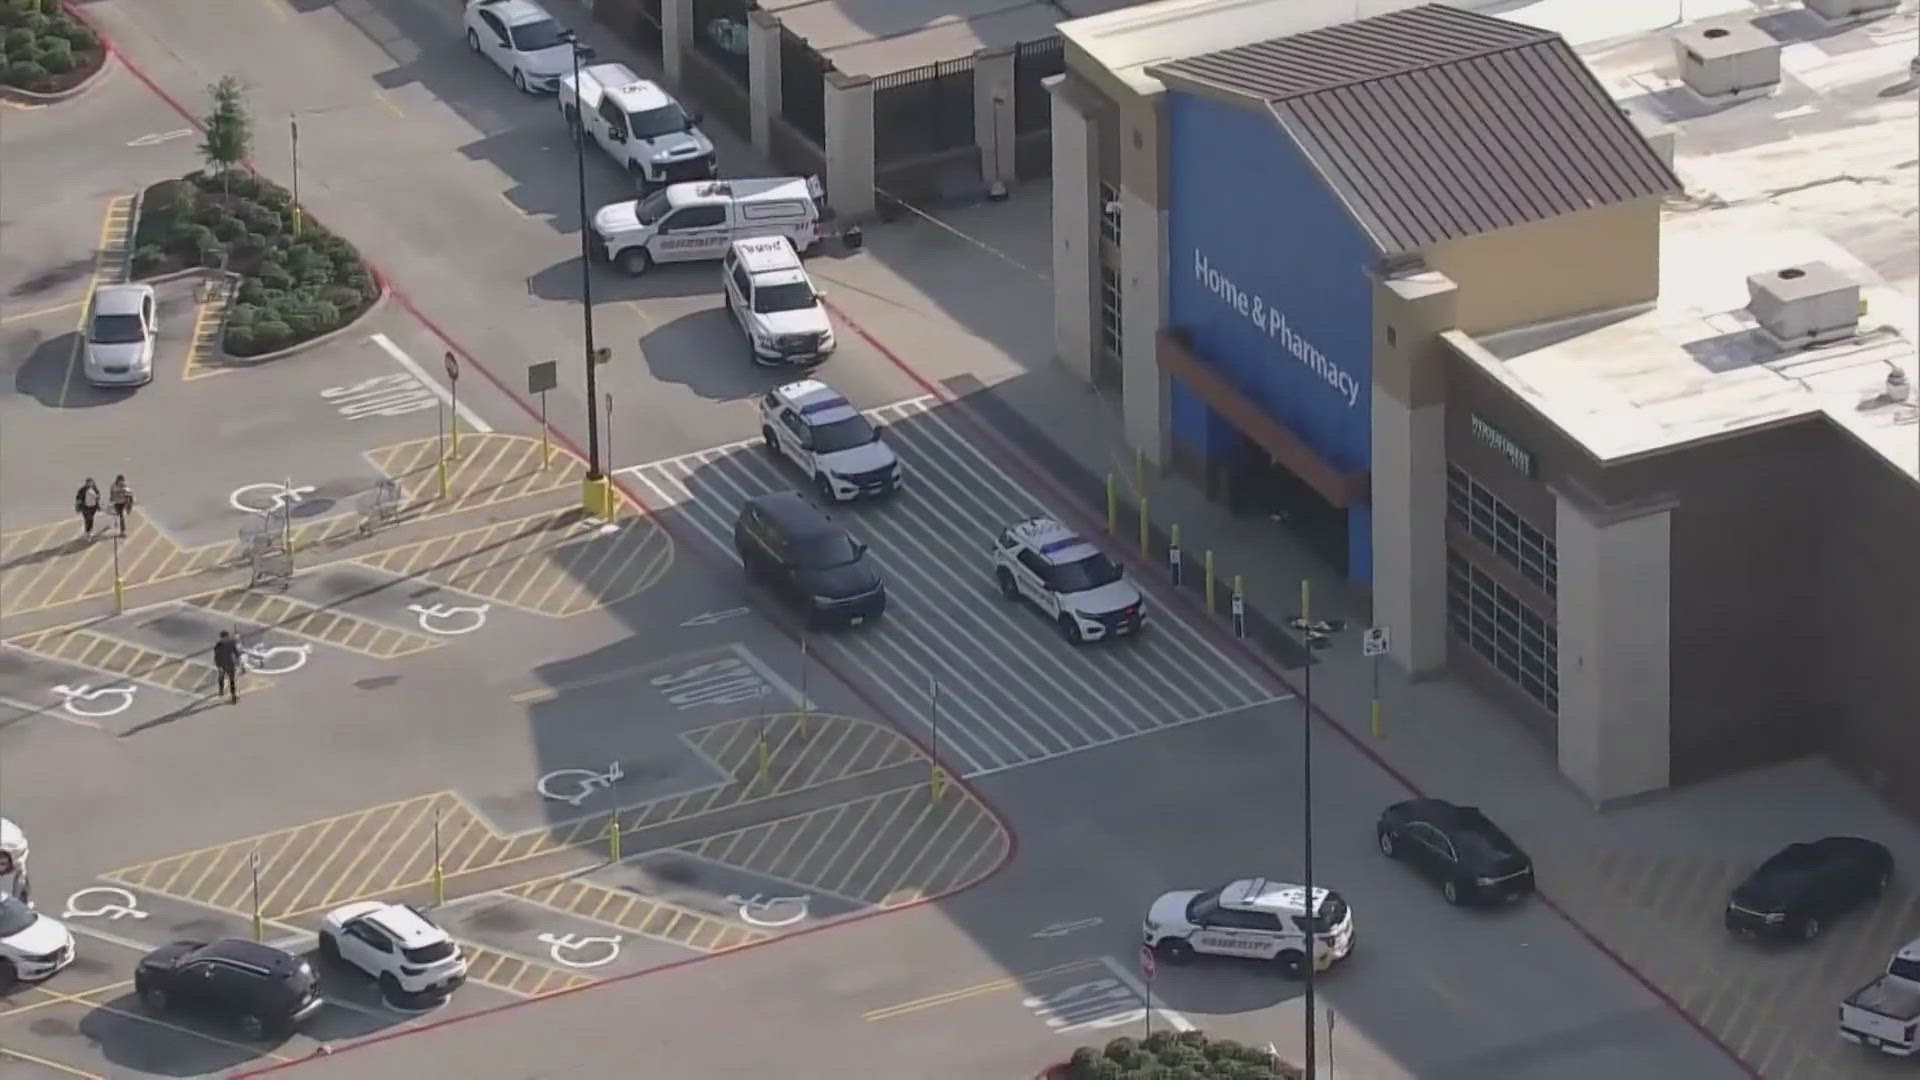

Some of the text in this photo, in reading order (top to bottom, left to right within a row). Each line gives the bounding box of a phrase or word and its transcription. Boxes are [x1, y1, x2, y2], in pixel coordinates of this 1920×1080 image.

[1194, 248, 1359, 407] Home & Pharmacy
